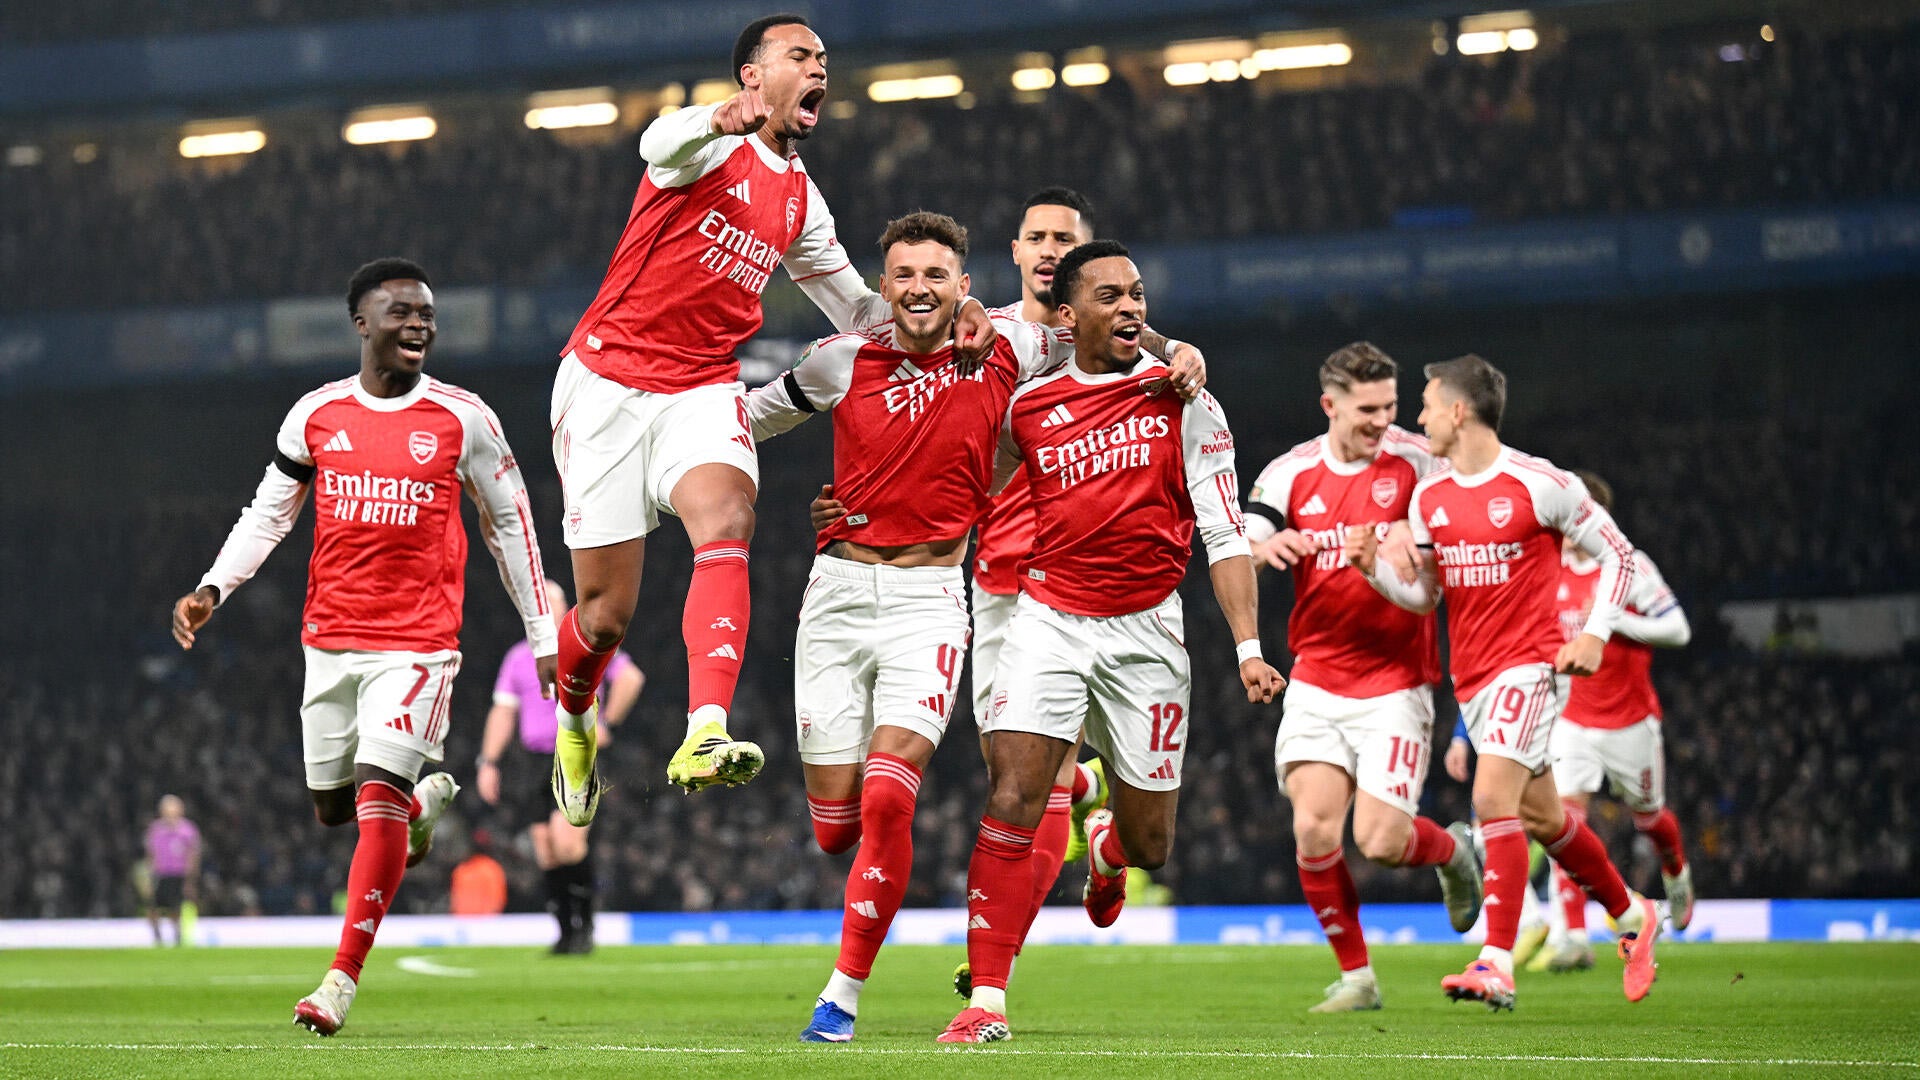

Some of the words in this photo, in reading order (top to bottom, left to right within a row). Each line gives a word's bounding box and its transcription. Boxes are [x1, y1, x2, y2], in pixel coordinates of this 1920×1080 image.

[699, 246, 733, 273] FLY
[727, 260, 769, 295] BETTER
[1036, 414, 1169, 474] Emirates
[1060, 460, 1087, 489] FLY
[1091, 443, 1151, 476] BETTER
[323, 469, 435, 503] Emirates
[334, 498, 361, 521] FLY
[361, 501, 419, 526] BETTER
[400, 662, 431, 708] 7
[936, 643, 958, 692] 4
[1148, 702, 1184, 752] 12
[1488, 684, 1526, 724] 19
[1387, 736, 1419, 778] 14
